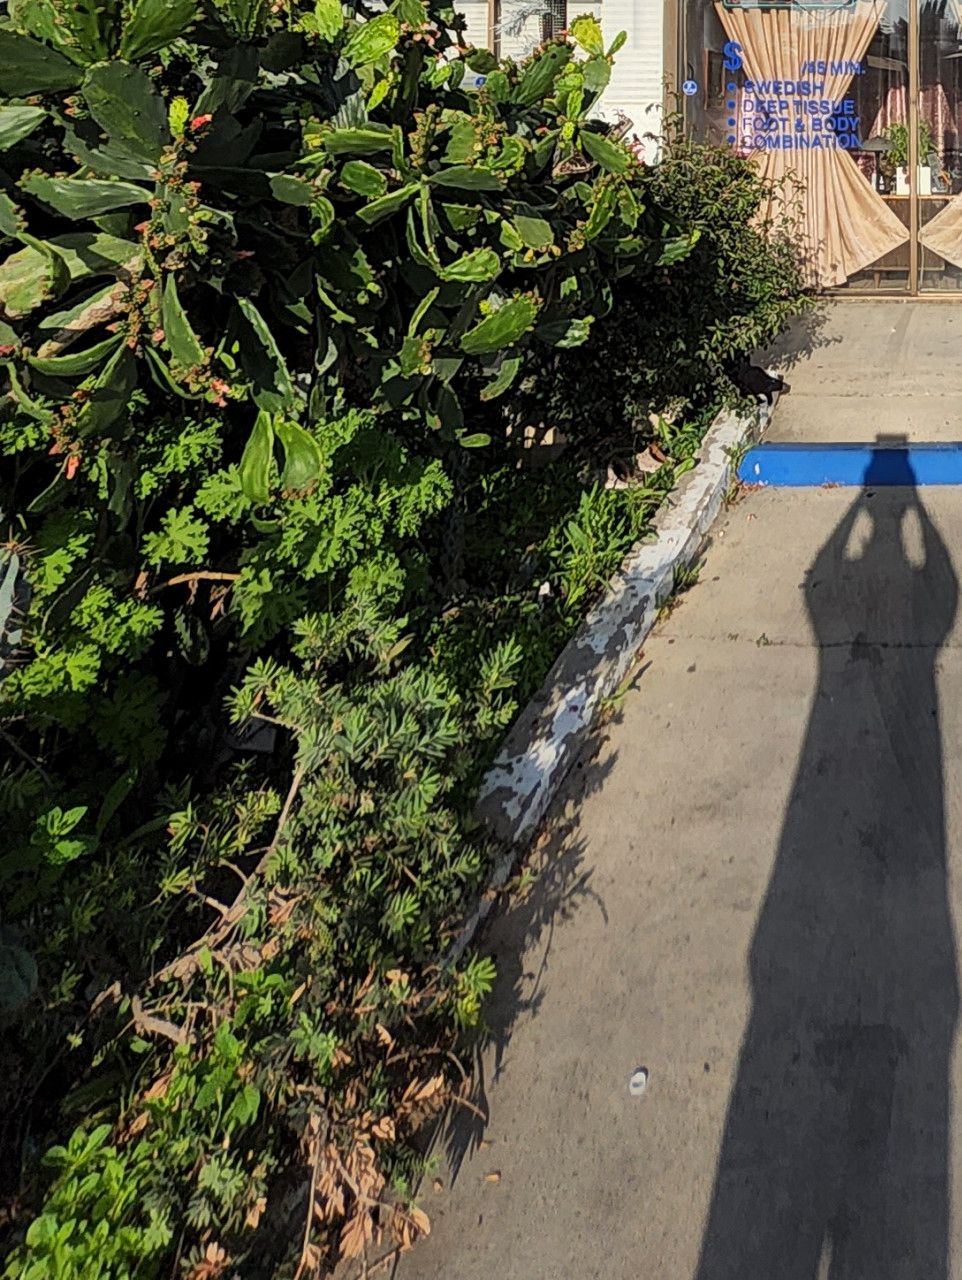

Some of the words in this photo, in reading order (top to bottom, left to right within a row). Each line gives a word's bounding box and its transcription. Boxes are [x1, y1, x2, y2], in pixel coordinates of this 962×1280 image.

[831, 60, 865, 76] MIN.
[744, 80, 825, 96] SWEDISH
[744, 99, 789, 114] DEEP
[793, 100, 854, 114] TISSUE
[743, 117, 788, 131] FOOT
[795, 118, 806, 132] &
[812, 117, 860, 132] BODY
[742, 134, 861, 149] COMBINATION
